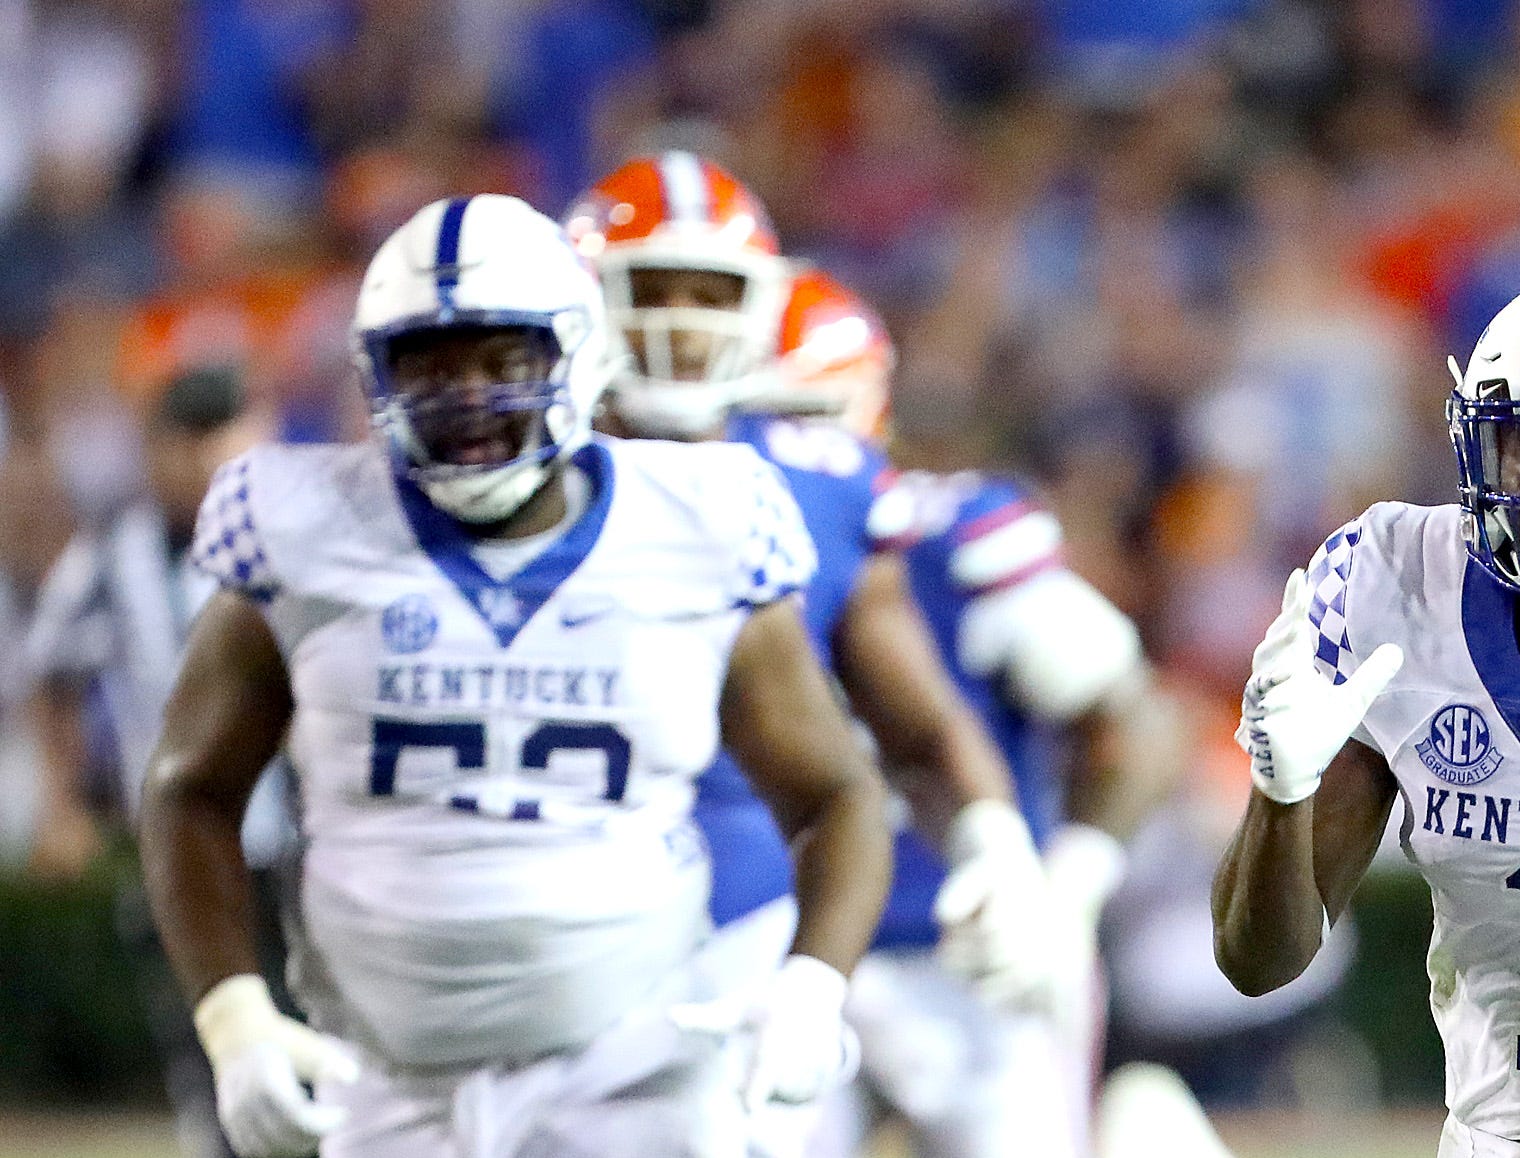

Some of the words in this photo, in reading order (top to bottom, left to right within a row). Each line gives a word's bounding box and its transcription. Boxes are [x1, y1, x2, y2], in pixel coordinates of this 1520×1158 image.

[377, 664, 620, 704] KENTUCKY
[1434, 706, 1489, 764] SEC
[1425, 754, 1491, 784] GRADUATE
